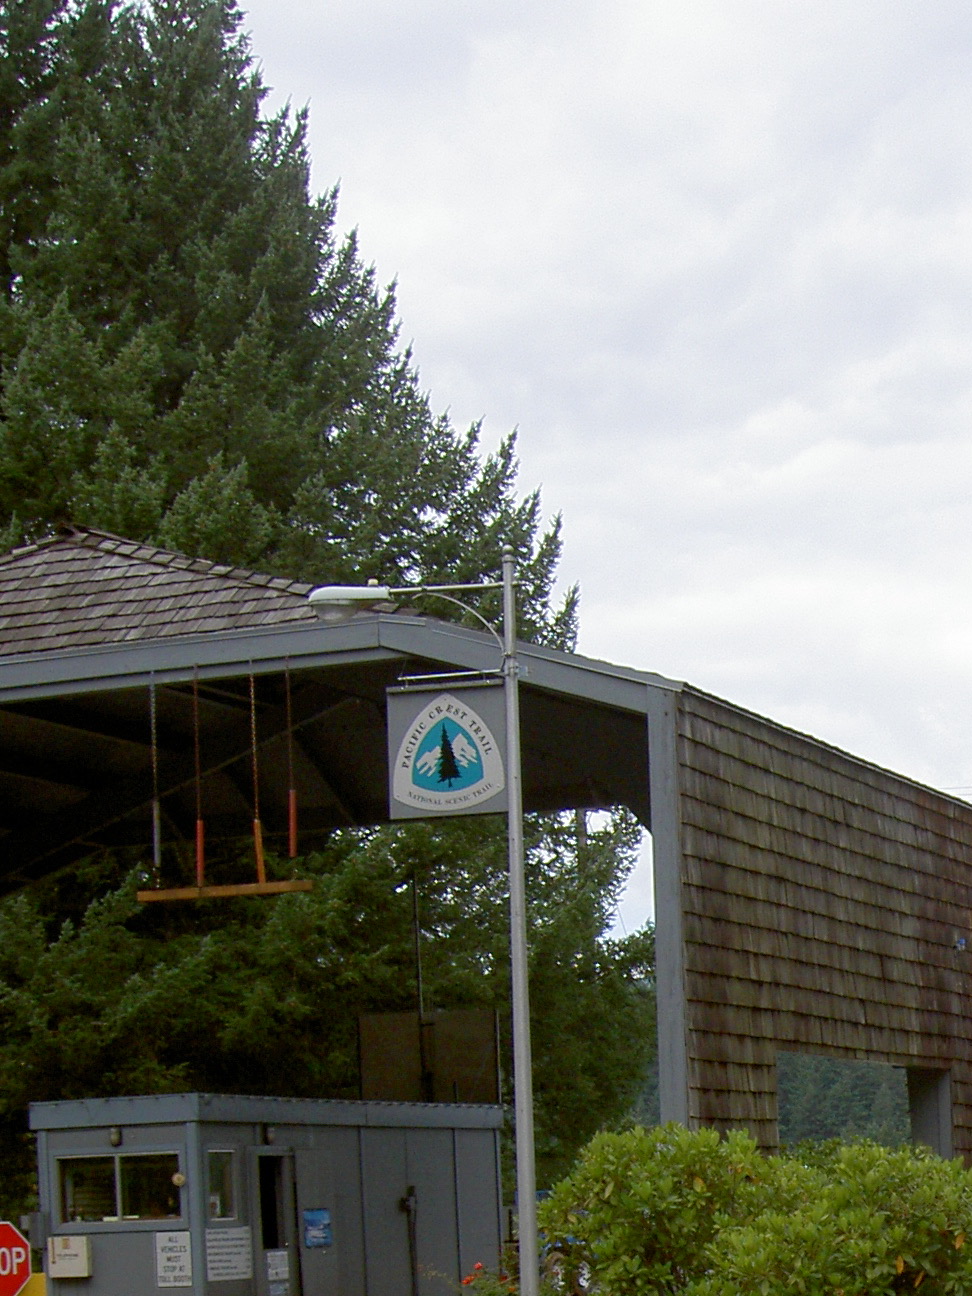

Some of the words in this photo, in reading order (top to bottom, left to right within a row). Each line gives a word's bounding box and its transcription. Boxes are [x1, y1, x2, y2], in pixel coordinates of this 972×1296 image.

[402, 722, 425, 768] PACIFIC
[428, 704, 467, 719] CREST
[469, 720, 492, 755] TRAIL
[408, 791, 442, 805] NATIONAL
[445, 794, 470, 804] SCENIC
[473, 783, 493, 797] TRAIL
[160, 1245, 188, 1253] VEHICLES
